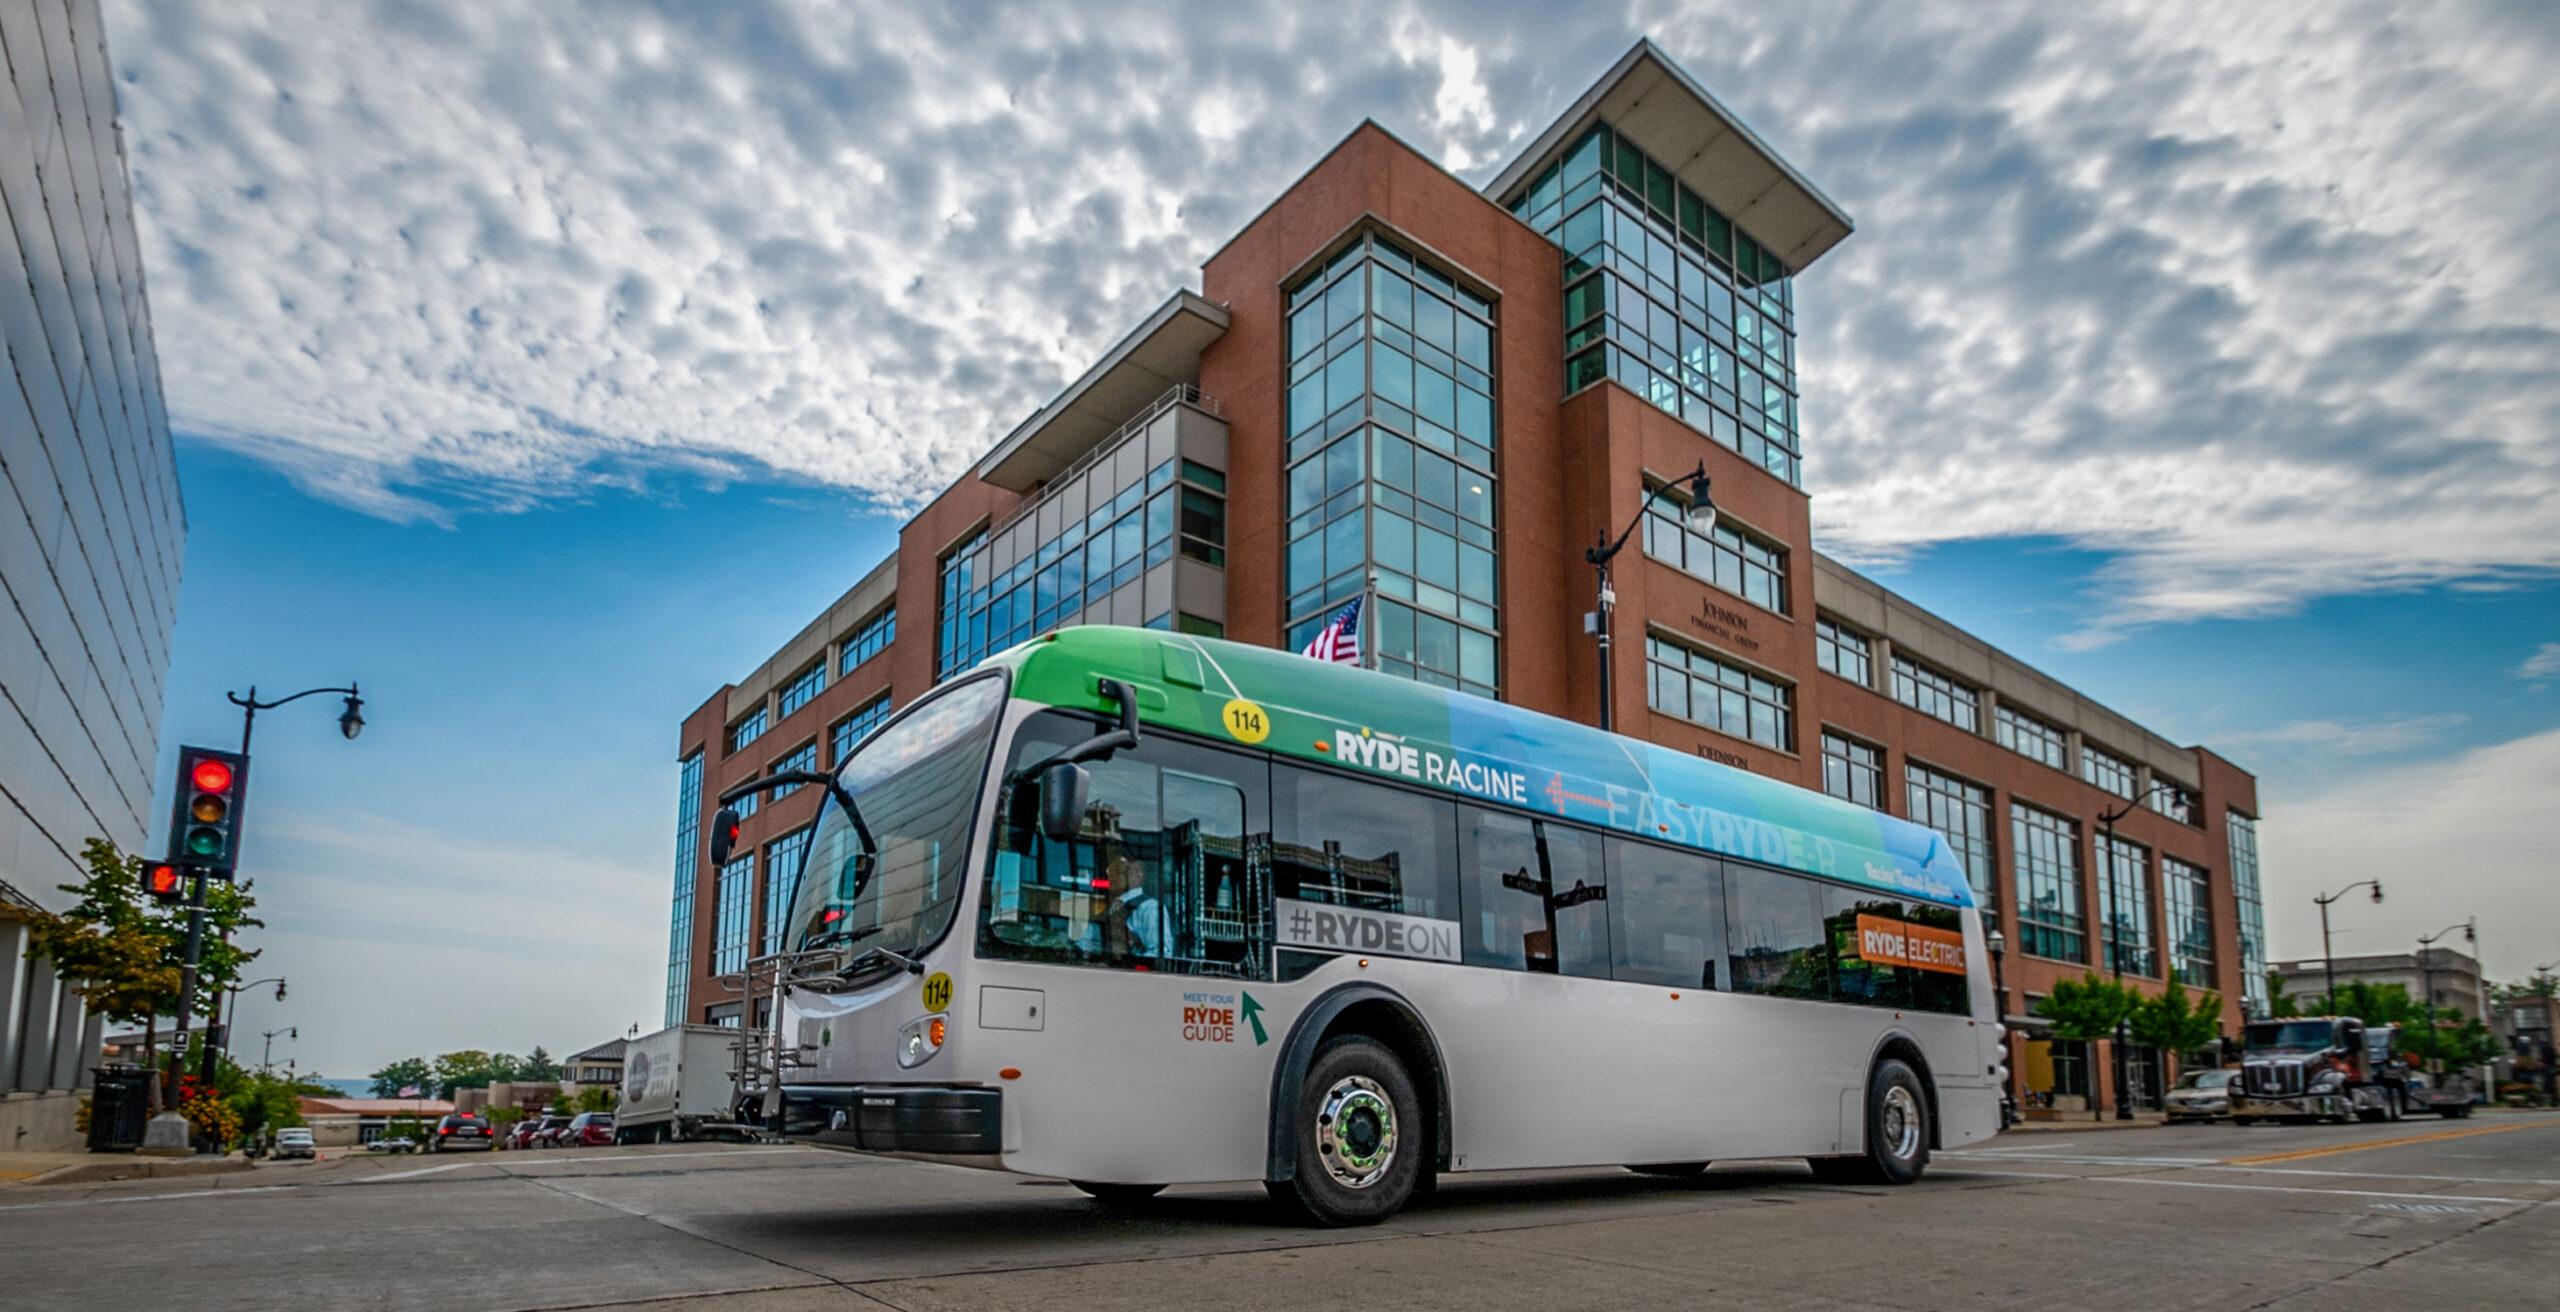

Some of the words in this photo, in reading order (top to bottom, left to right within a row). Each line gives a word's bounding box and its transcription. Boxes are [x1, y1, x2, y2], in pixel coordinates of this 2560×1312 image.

[1703, 597, 1748, 631] JOHNSON
[1691, 615, 1730, 640] FINANCIAL
[1734, 634, 1759, 651] GROUP
[1232, 709, 1261, 733] 114
[1335, 729, 1420, 779] RYDE
[1425, 752, 1528, 804] RACINE
[1697, 744, 1748, 770] JOHNSON
[1289, 908, 1450, 957] #RYDEON
[1864, 929, 1906, 958] RYDE
[1908, 938, 1964, 967] ELECTRIC
[927, 980, 949, 1005] 114
[1183, 993, 1208, 1003] MEET
[1209, 994, 1234, 1004] YOUR
[1183, 1006, 1234, 1026] RYDE
[1183, 1025, 1234, 1043] GUIDE
